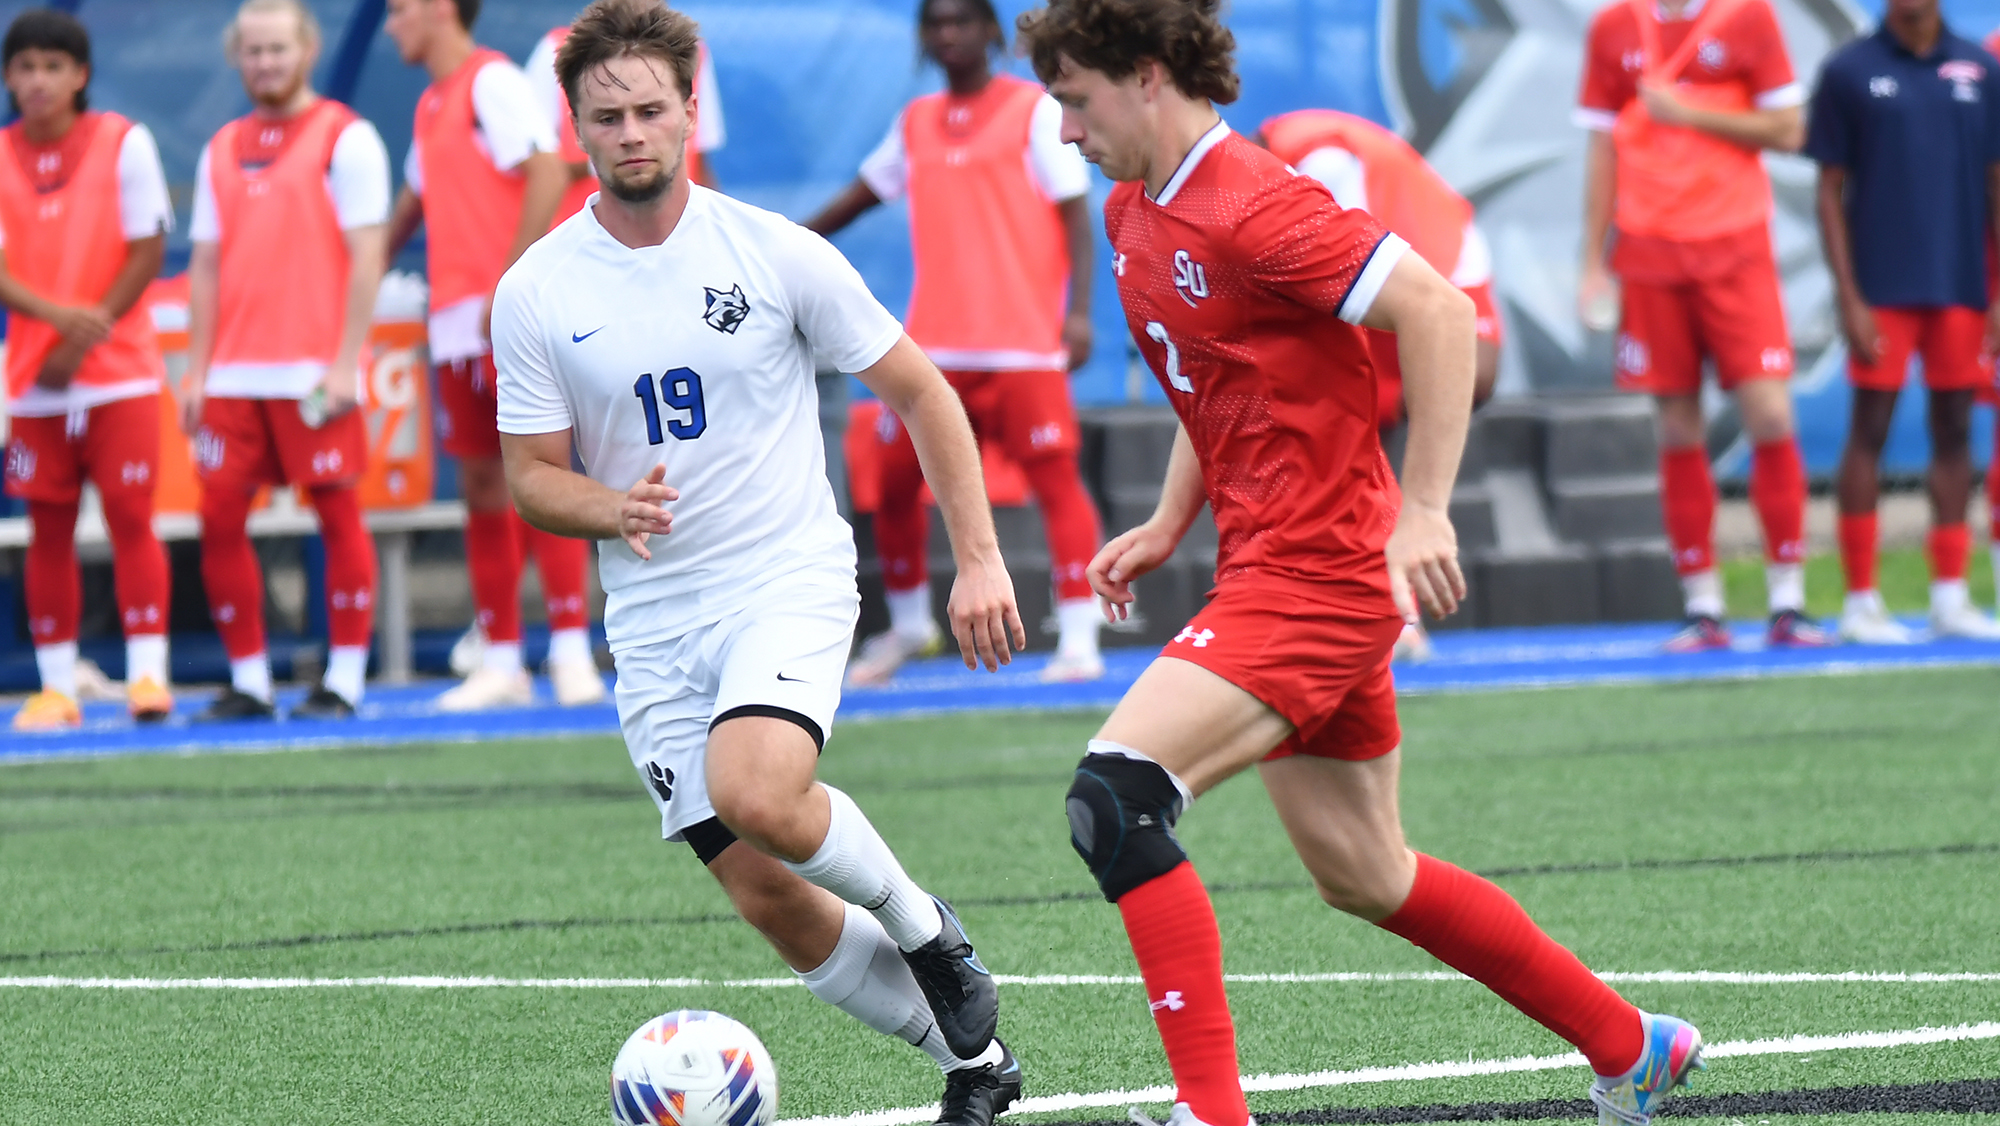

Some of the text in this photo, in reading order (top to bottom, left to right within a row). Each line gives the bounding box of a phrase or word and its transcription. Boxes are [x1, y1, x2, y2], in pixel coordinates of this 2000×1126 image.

[1174, 249, 1209, 298] SU
[374, 351, 417, 409] G
[1145, 321, 1195, 394] 2
[633, 366, 707, 446] 19
